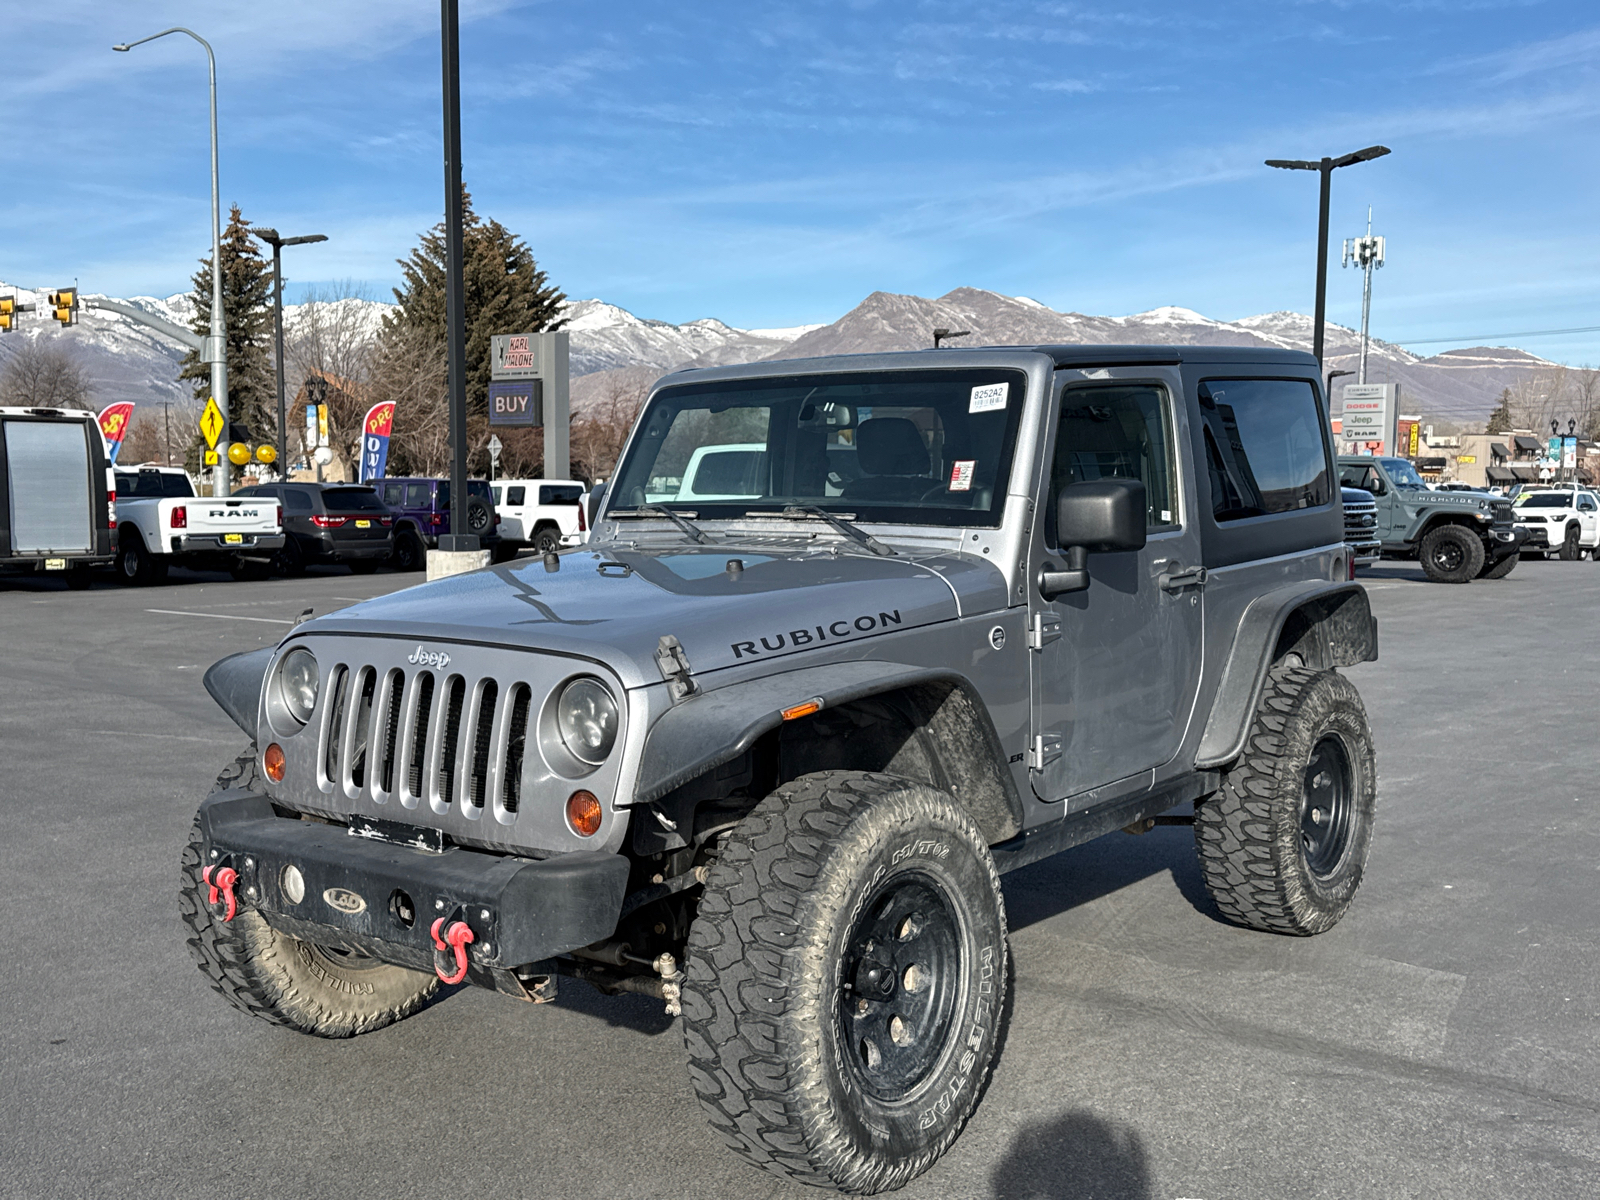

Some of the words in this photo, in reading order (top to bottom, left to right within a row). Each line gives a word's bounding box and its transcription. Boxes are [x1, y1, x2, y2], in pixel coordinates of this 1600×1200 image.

[508, 337, 529, 352] KARL
[503, 353, 534, 368] MALONE
[974, 387, 1003, 399] 8252A2
[495, 396, 528, 412] BUY
[369, 406, 392, 433] PRE
[1351, 415, 1373, 424] Jeep
[366, 436, 380, 480] OWN
[730, 609, 902, 659] RUBICON
[408, 645, 451, 671] Jeep
[1009, 753, 1024, 764] ER
[294, 940, 375, 996] MILES
[919, 945, 993, 1130] MILESTAR
